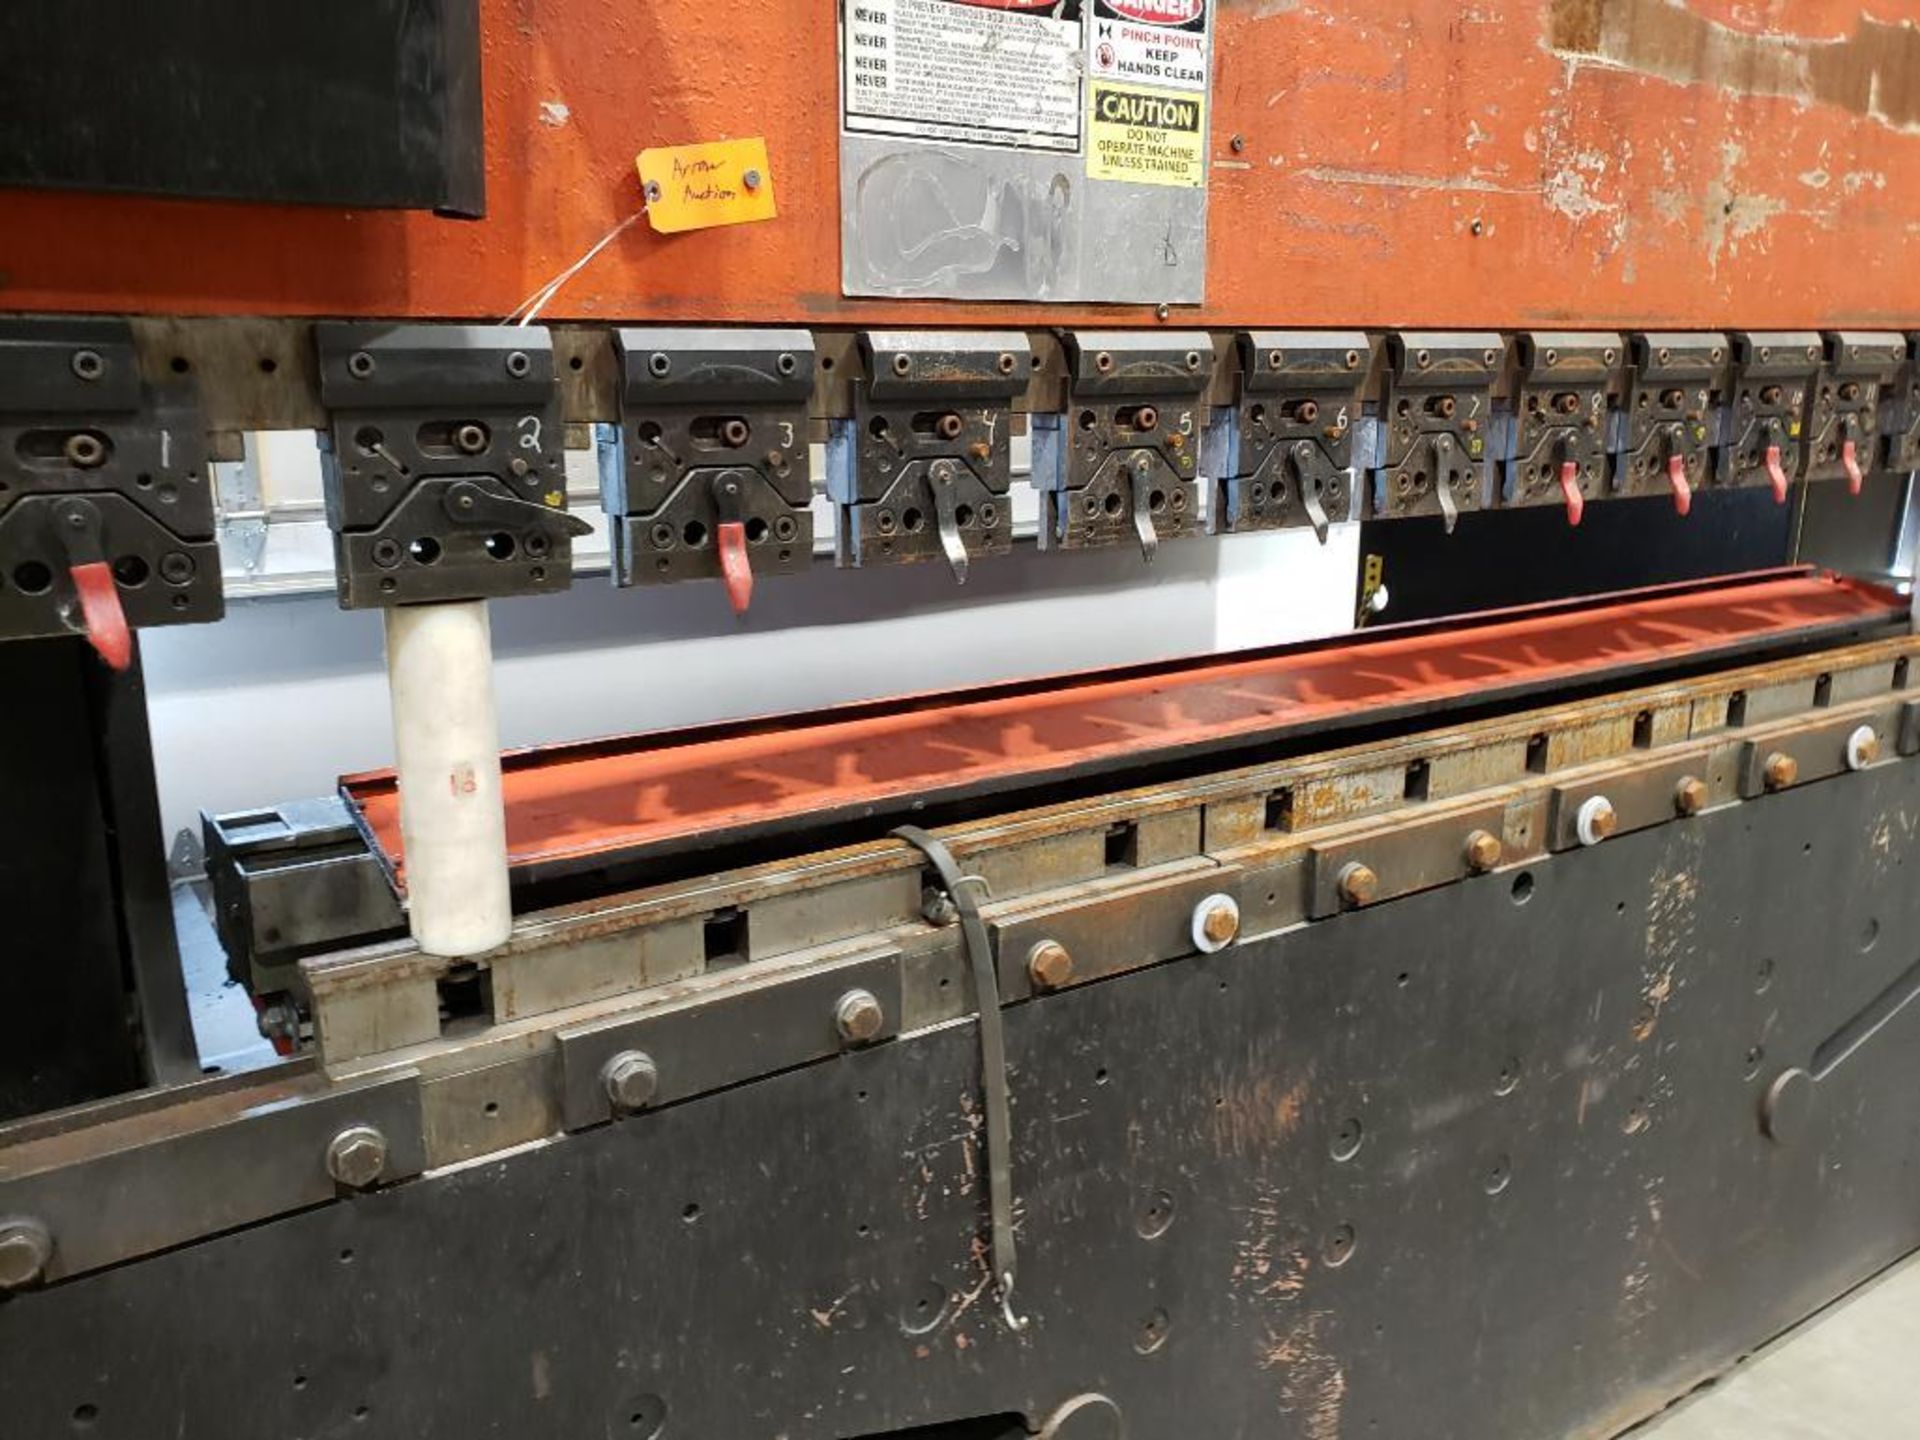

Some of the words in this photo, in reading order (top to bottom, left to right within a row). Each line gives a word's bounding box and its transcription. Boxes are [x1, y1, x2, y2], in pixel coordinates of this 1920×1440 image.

[855, 8, 887, 25] NEVER
[855, 33, 887, 49] NEVER
[1121, 27, 1161, 43] PINCH
[1164, 35, 1203, 50] POINT
[855, 56, 887, 72] NEVER
[1145, 48, 1179, 63] KEEP
[855, 73, 887, 89] NEVER
[1118, 60, 1161, 76] HANDS
[1164, 66, 1204, 83] CLEAR
[1103, 95, 1193, 128] CAUTION
[1127, 129, 1144, 141] DO
[1146, 131, 1168, 143] NOT
[1097, 140, 1145, 154] OPERATE
[1147, 145, 1195, 160] MACHINE
[1103, 155, 1144, 168] UNLESS
[1145, 159, 1189, 173] TRAINED
[1469, 394, 1481, 419] 7
[1698, 389, 1709, 411] 9
[983, 409, 998, 446] 4
[1179, 410, 1193, 436] 5
[1336, 406, 1349, 430] 6
[517, 415, 542, 454] 2
[779, 421, 794, 449] 3
[161, 430, 170, 468] 1
